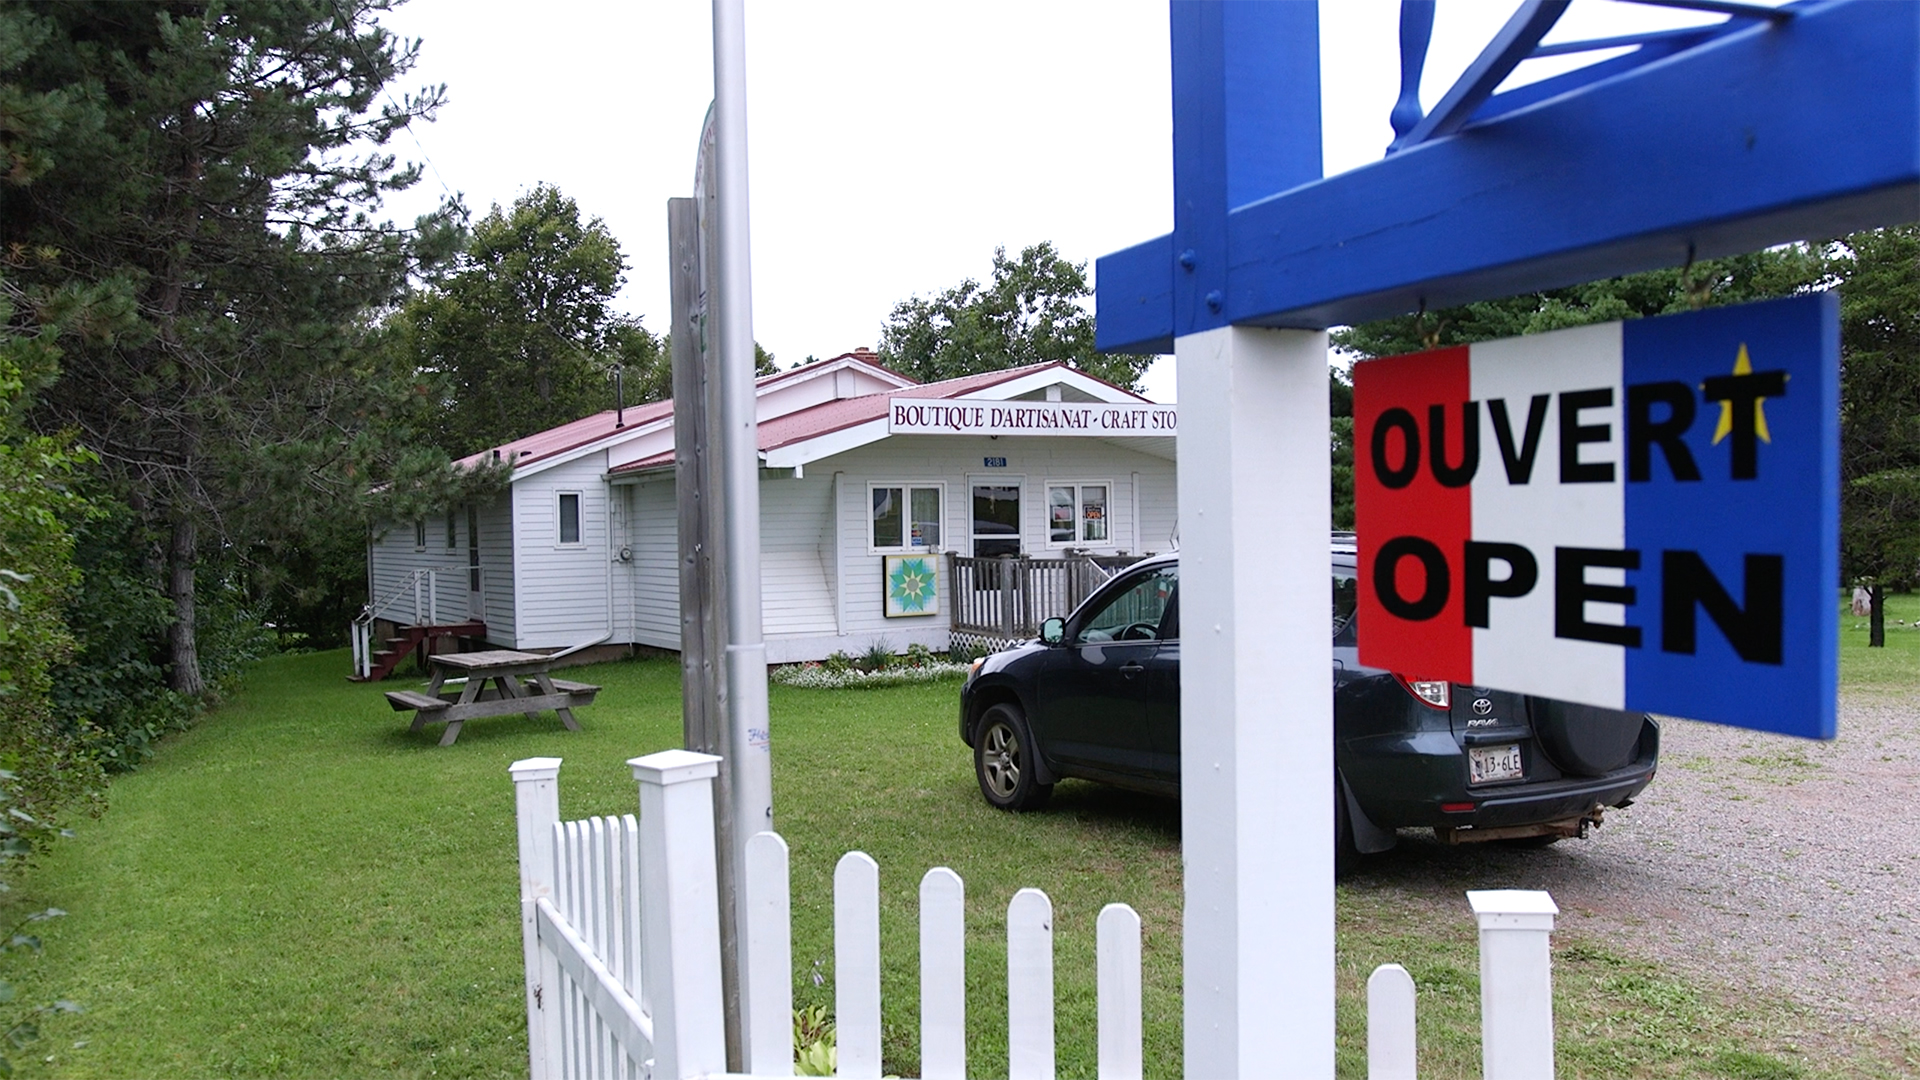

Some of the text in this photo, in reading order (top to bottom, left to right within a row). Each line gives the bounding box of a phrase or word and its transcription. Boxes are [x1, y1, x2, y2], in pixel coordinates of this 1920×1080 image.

[895, 405, 984, 430] BOUTIQUE
[990, 408, 1091, 429] D'ARTISANAT
[1101, 409, 1148, 429] CRAFT
[1152, 410, 1178, 429] STO
[1371, 370, 1786, 489] OUVERT
[987, 457, 1004, 467] 2181
[1373, 534, 1785, 665] OPEN
